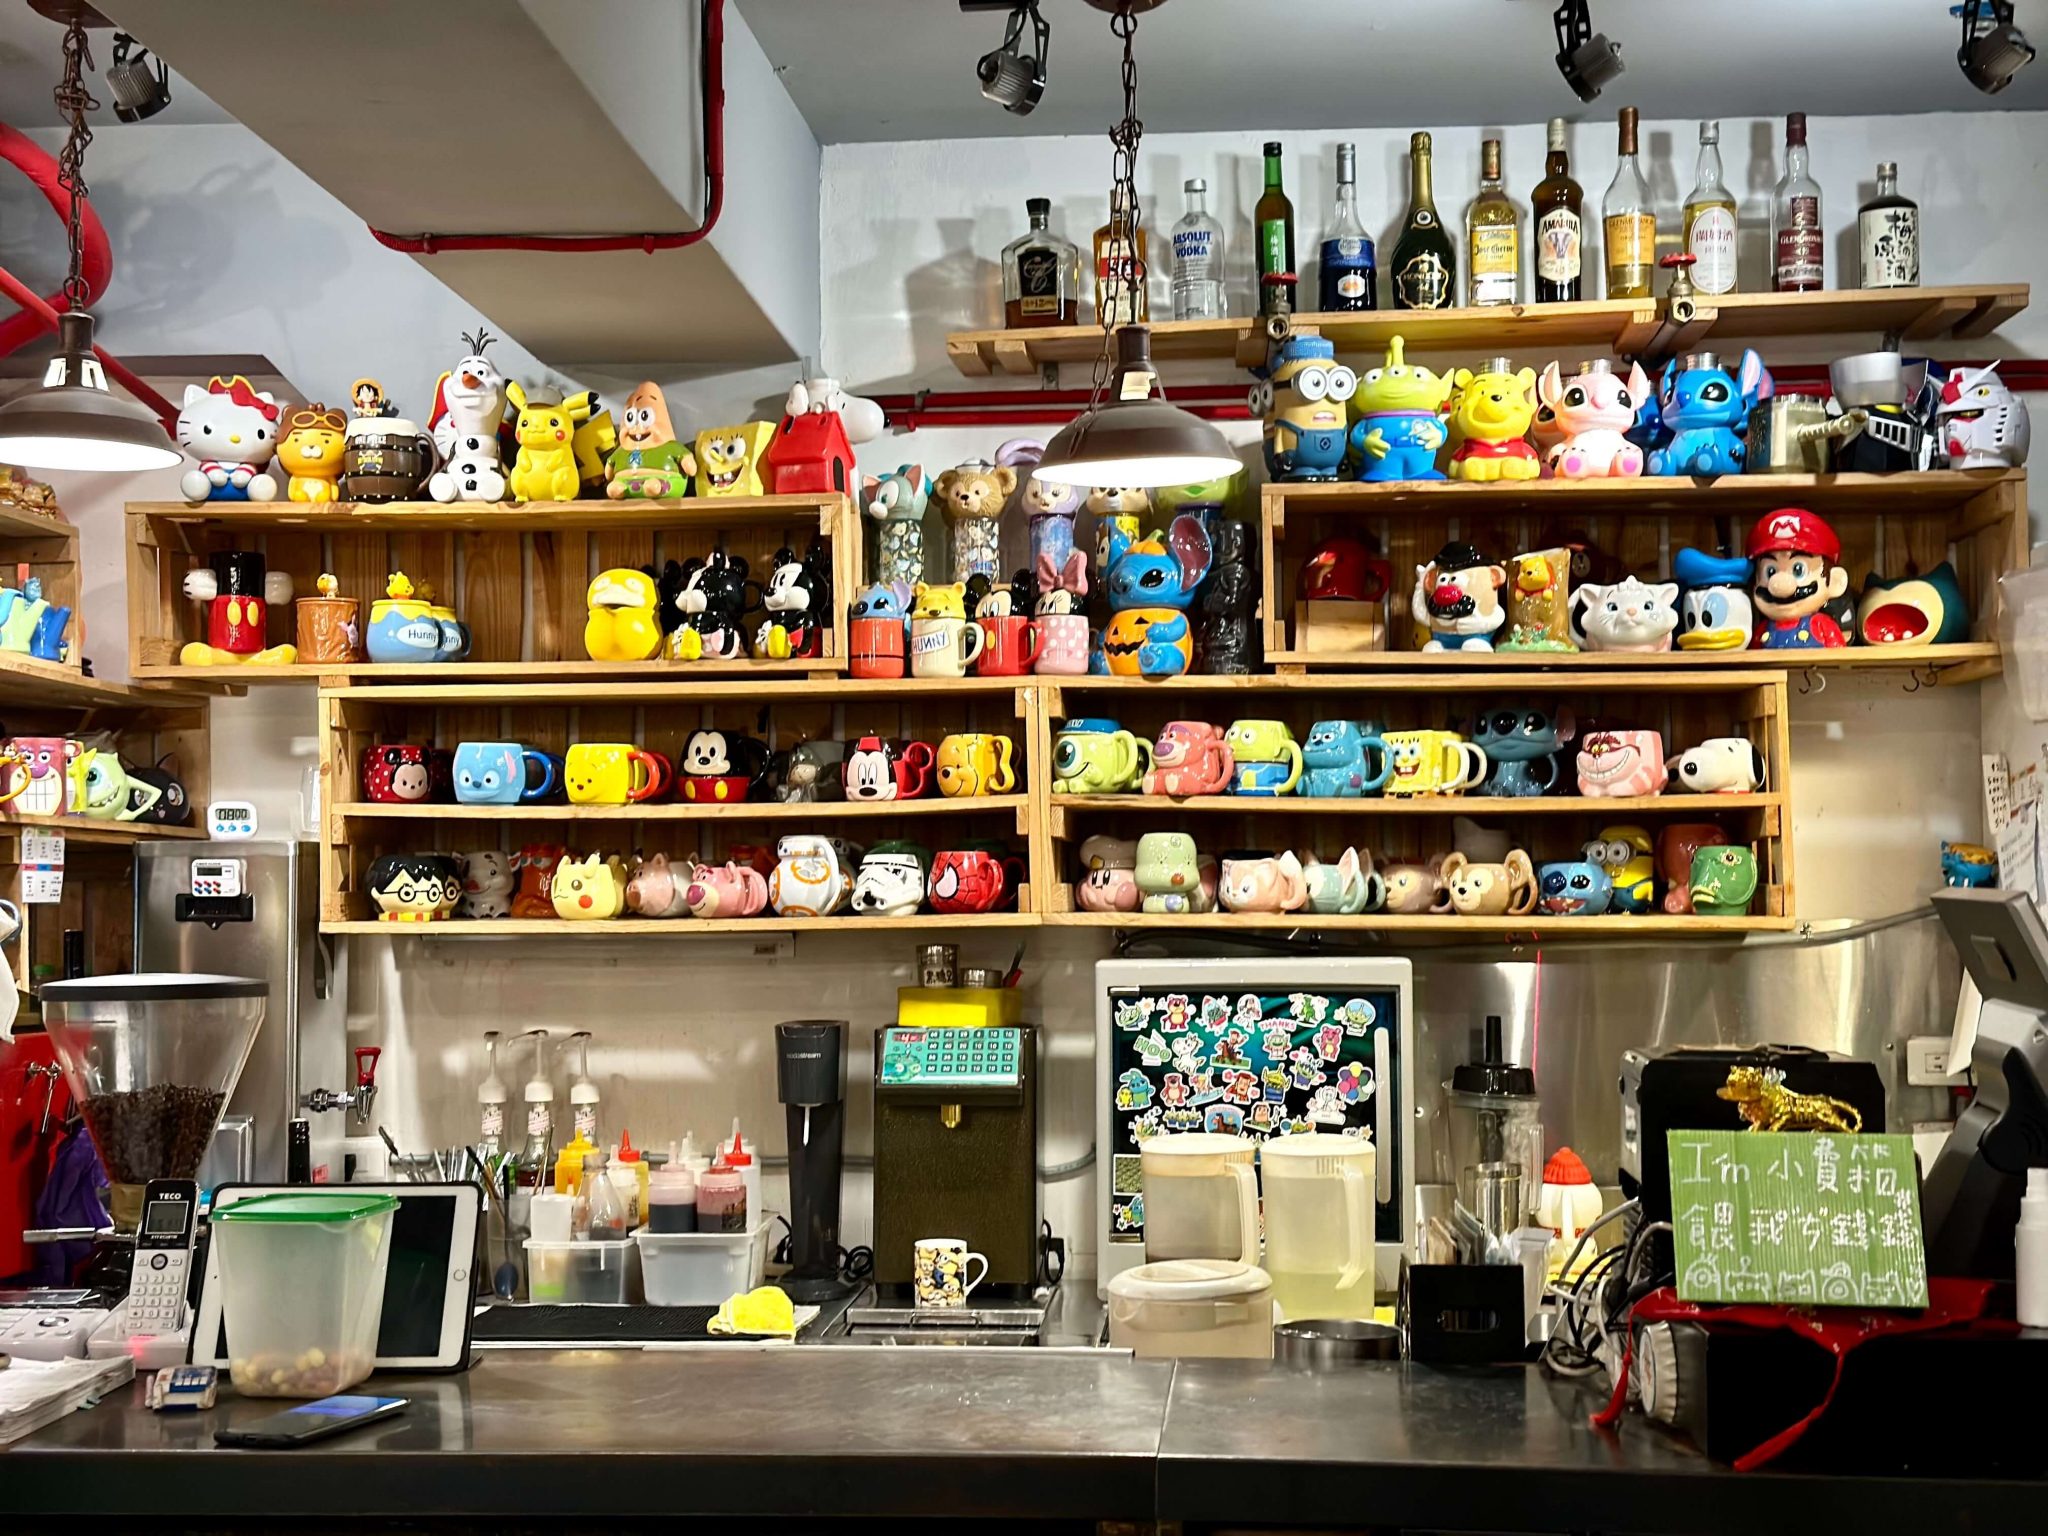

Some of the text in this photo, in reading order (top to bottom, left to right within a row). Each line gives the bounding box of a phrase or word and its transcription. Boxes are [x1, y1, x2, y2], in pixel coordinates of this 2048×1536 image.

[1173, 231, 1212, 245] ABSOLUT
[1176, 246, 1208, 258] VODKA
[408, 629, 436, 643] Hunny
[1259, 1019, 1297, 1032] THANKS
[158, 1192, 182, 1200] TECO
